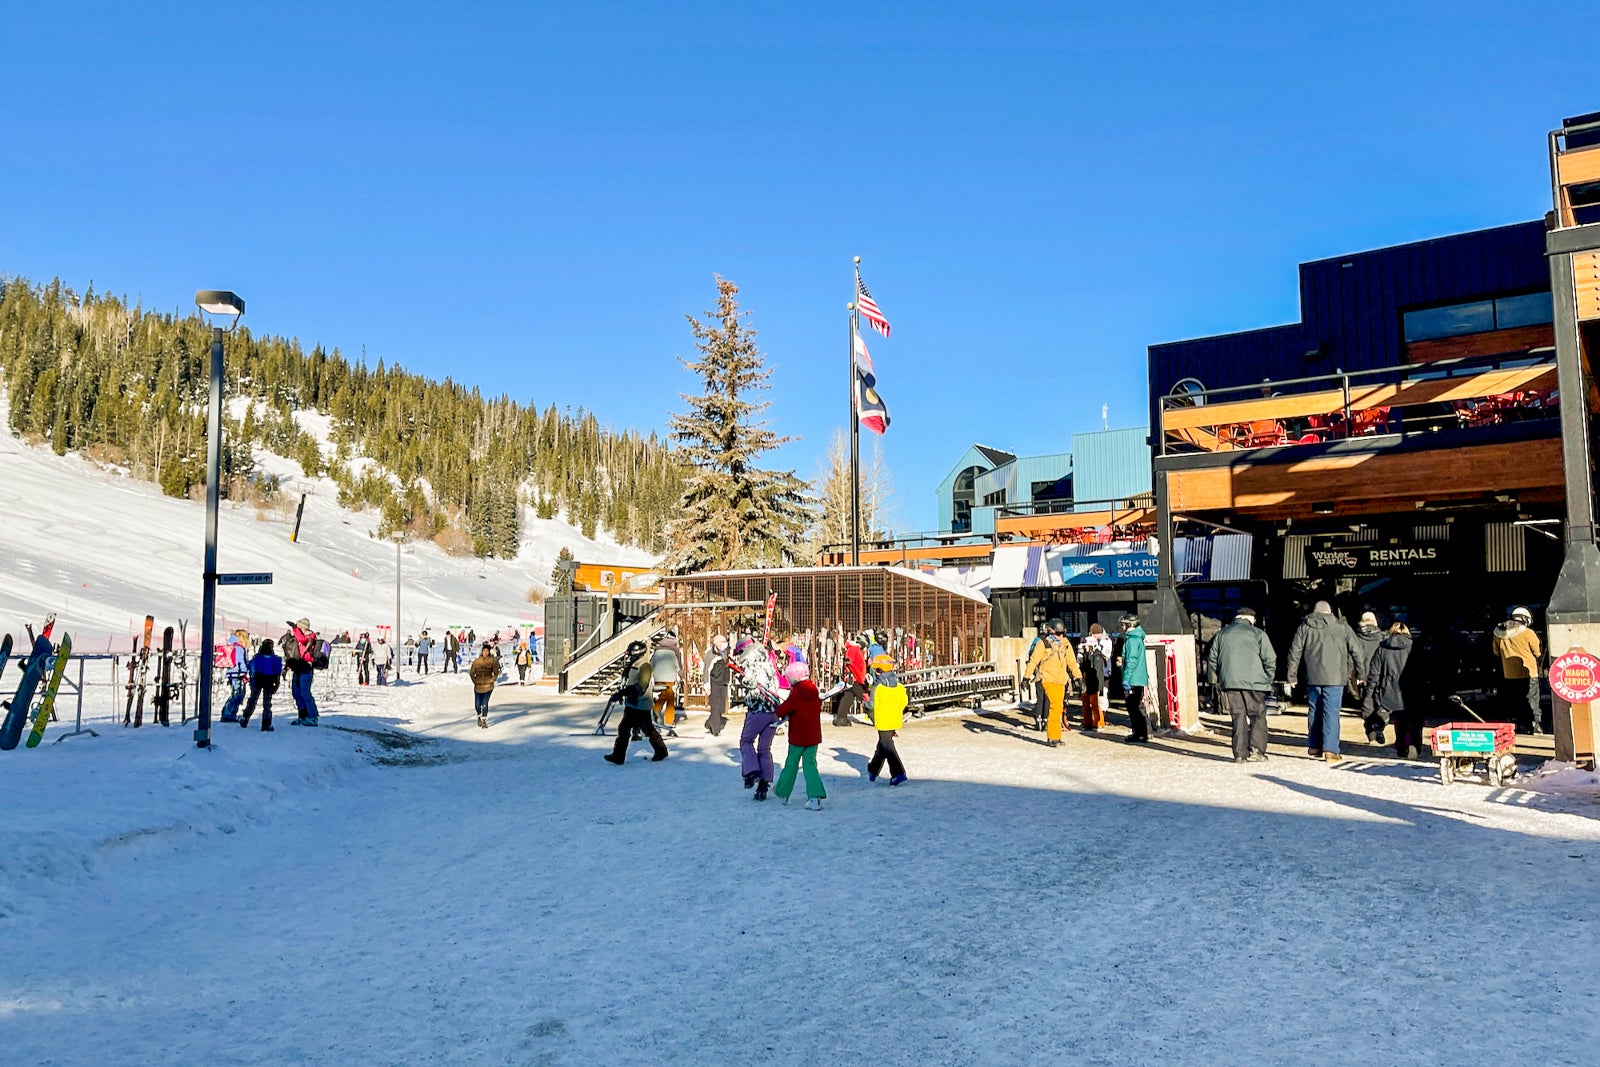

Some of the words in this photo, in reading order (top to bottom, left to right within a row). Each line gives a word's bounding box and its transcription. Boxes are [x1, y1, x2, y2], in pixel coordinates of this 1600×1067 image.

[1312, 551, 1349, 560] Winter
[1370, 548, 1437, 560] RENTALS
[1116, 560, 1132, 568] SKI
[1142, 559, 1159, 567] RID
[1117, 569, 1158, 577] SCHOOL
[1556, 655, 1597, 669] WAGON
[1565, 669, 1590, 677] WAGON
[1564, 678, 1591, 686] SERVICE
[1554, 681, 1600, 700] DROP-OFF
